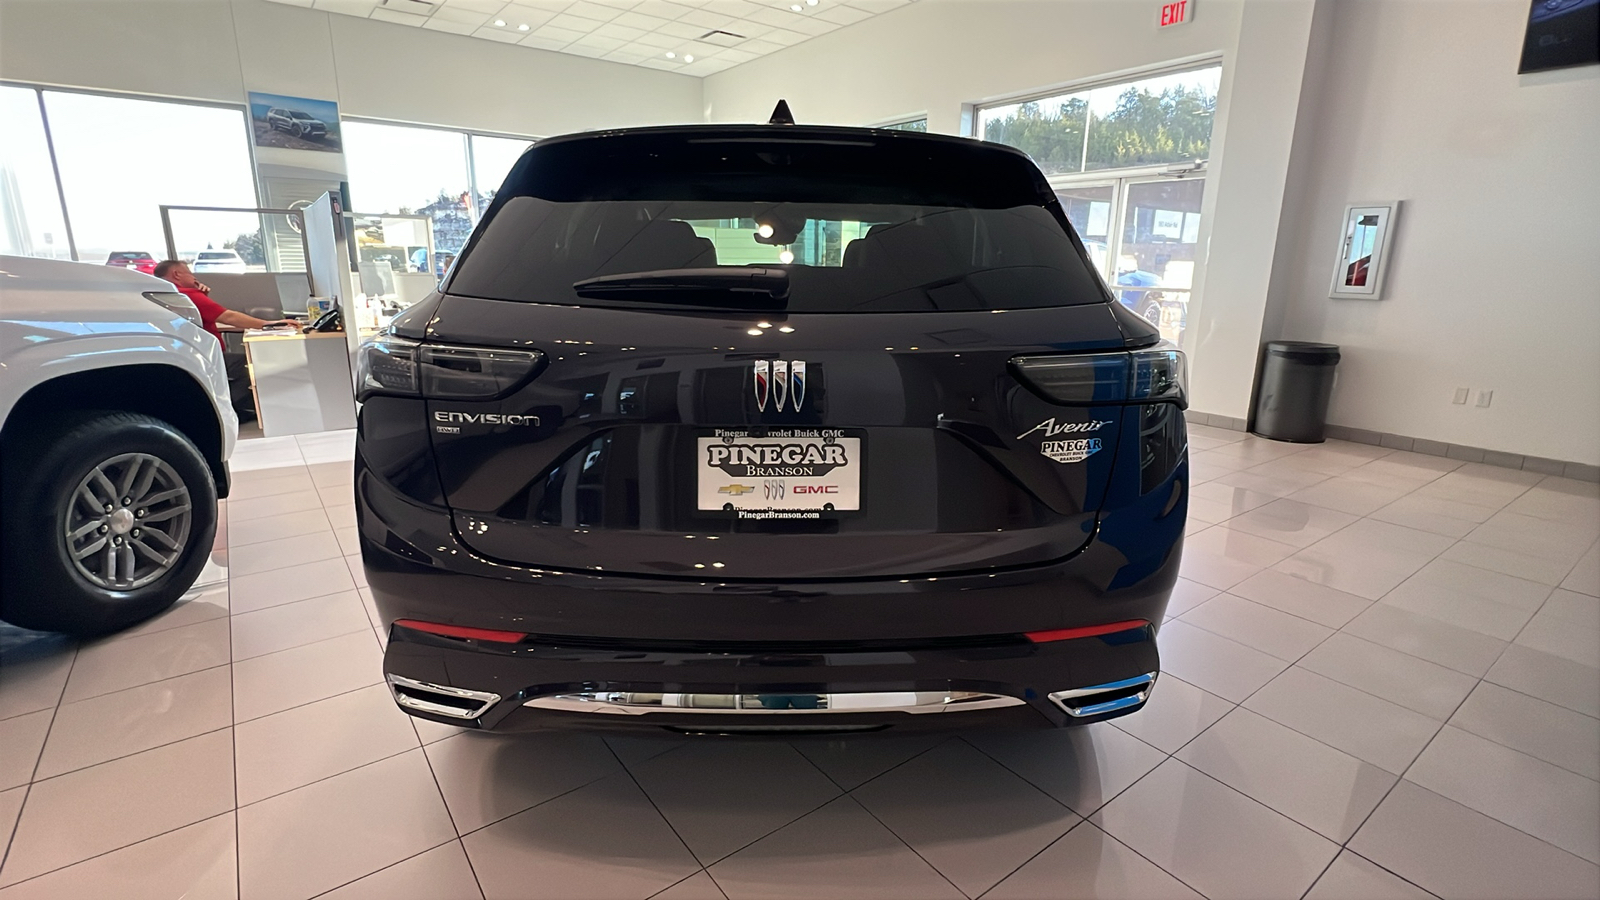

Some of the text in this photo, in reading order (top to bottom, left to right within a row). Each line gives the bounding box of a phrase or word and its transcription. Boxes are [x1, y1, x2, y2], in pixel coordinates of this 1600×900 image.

[1161, 0, 1187, 26] EXIT
[715, 429, 748, 438] Pinegar
[767, 429, 792, 437] vrolet
[794, 429, 819, 437] Buick
[1017, 417, 1113, 440] Avenir
[1042, 439, 1101, 453] PINEGAR
[709, 445, 846, 465] PINEGAR
[793, 485, 839, 494] GMC
[738, 511, 820, 519] PinegarBranson.com
